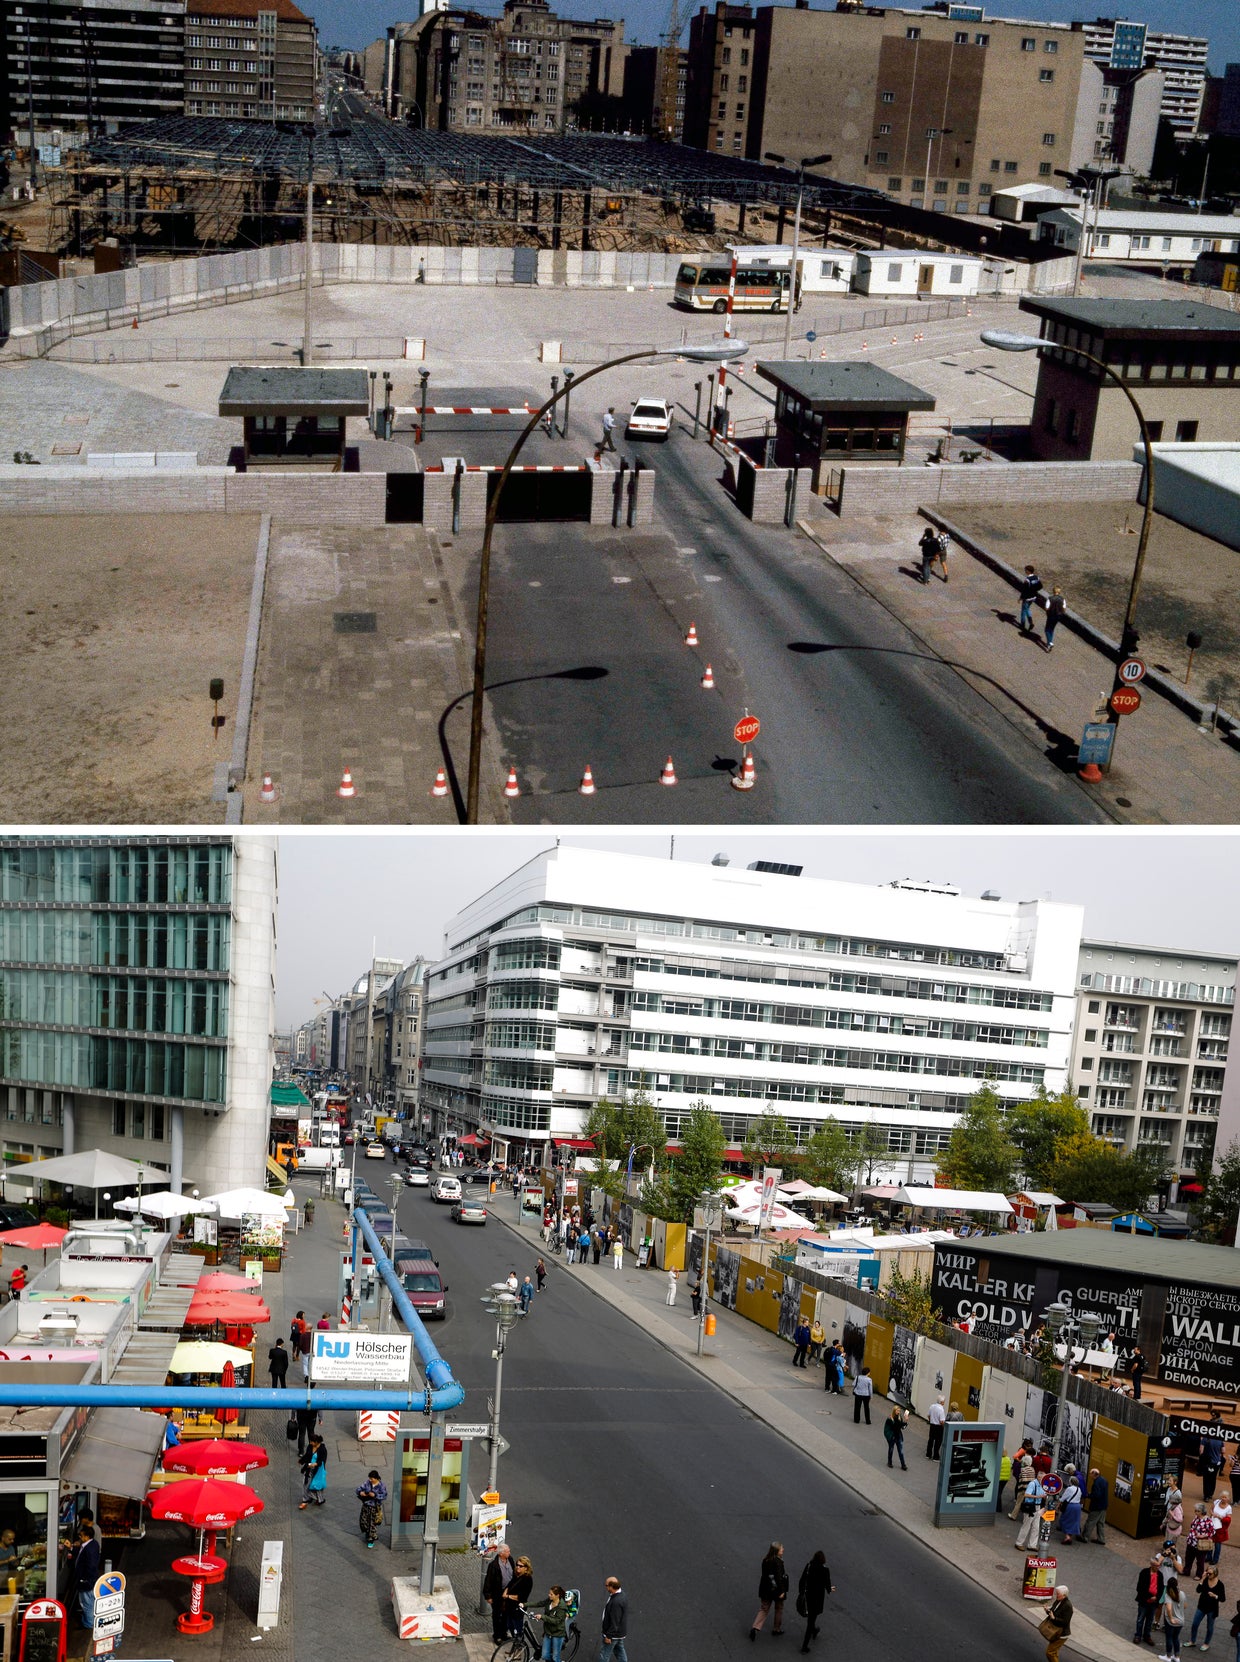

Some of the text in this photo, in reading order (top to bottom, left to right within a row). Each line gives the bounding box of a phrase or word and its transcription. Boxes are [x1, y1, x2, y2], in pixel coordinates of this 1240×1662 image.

[1126, 664, 1138, 677] 10
[1113, 695, 1138, 706] STOP
[736, 723, 758, 736] STOP
[935, 1251, 976, 1271] МИР
[1076, 1287, 1139, 1308] GUERRE
[1180, 1287, 1238, 1304] ВЫЕЗЖАЕТЕ
[957, 1299, 1017, 1327] COLD
[1171, 1314, 1240, 1347] WALL
[355, 1341, 407, 1354] Hölscher
[1161, 1335, 1214, 1353] WEAPON
[355, 1352, 405, 1360] Wasserbau
[1176, 1348, 1234, 1366] SPIONAGE
[1164, 1370, 1240, 1394] DEMOCRACY
[449, 1426, 486, 1434] Zimmerstraße
[207, 1466, 228, 1475] Coca-Cola
[164, 1511, 183, 1521] Coca-Cola
[205, 1512, 226, 1521] Coca-Cola
[190, 1581, 203, 1615] Coca-Cola
